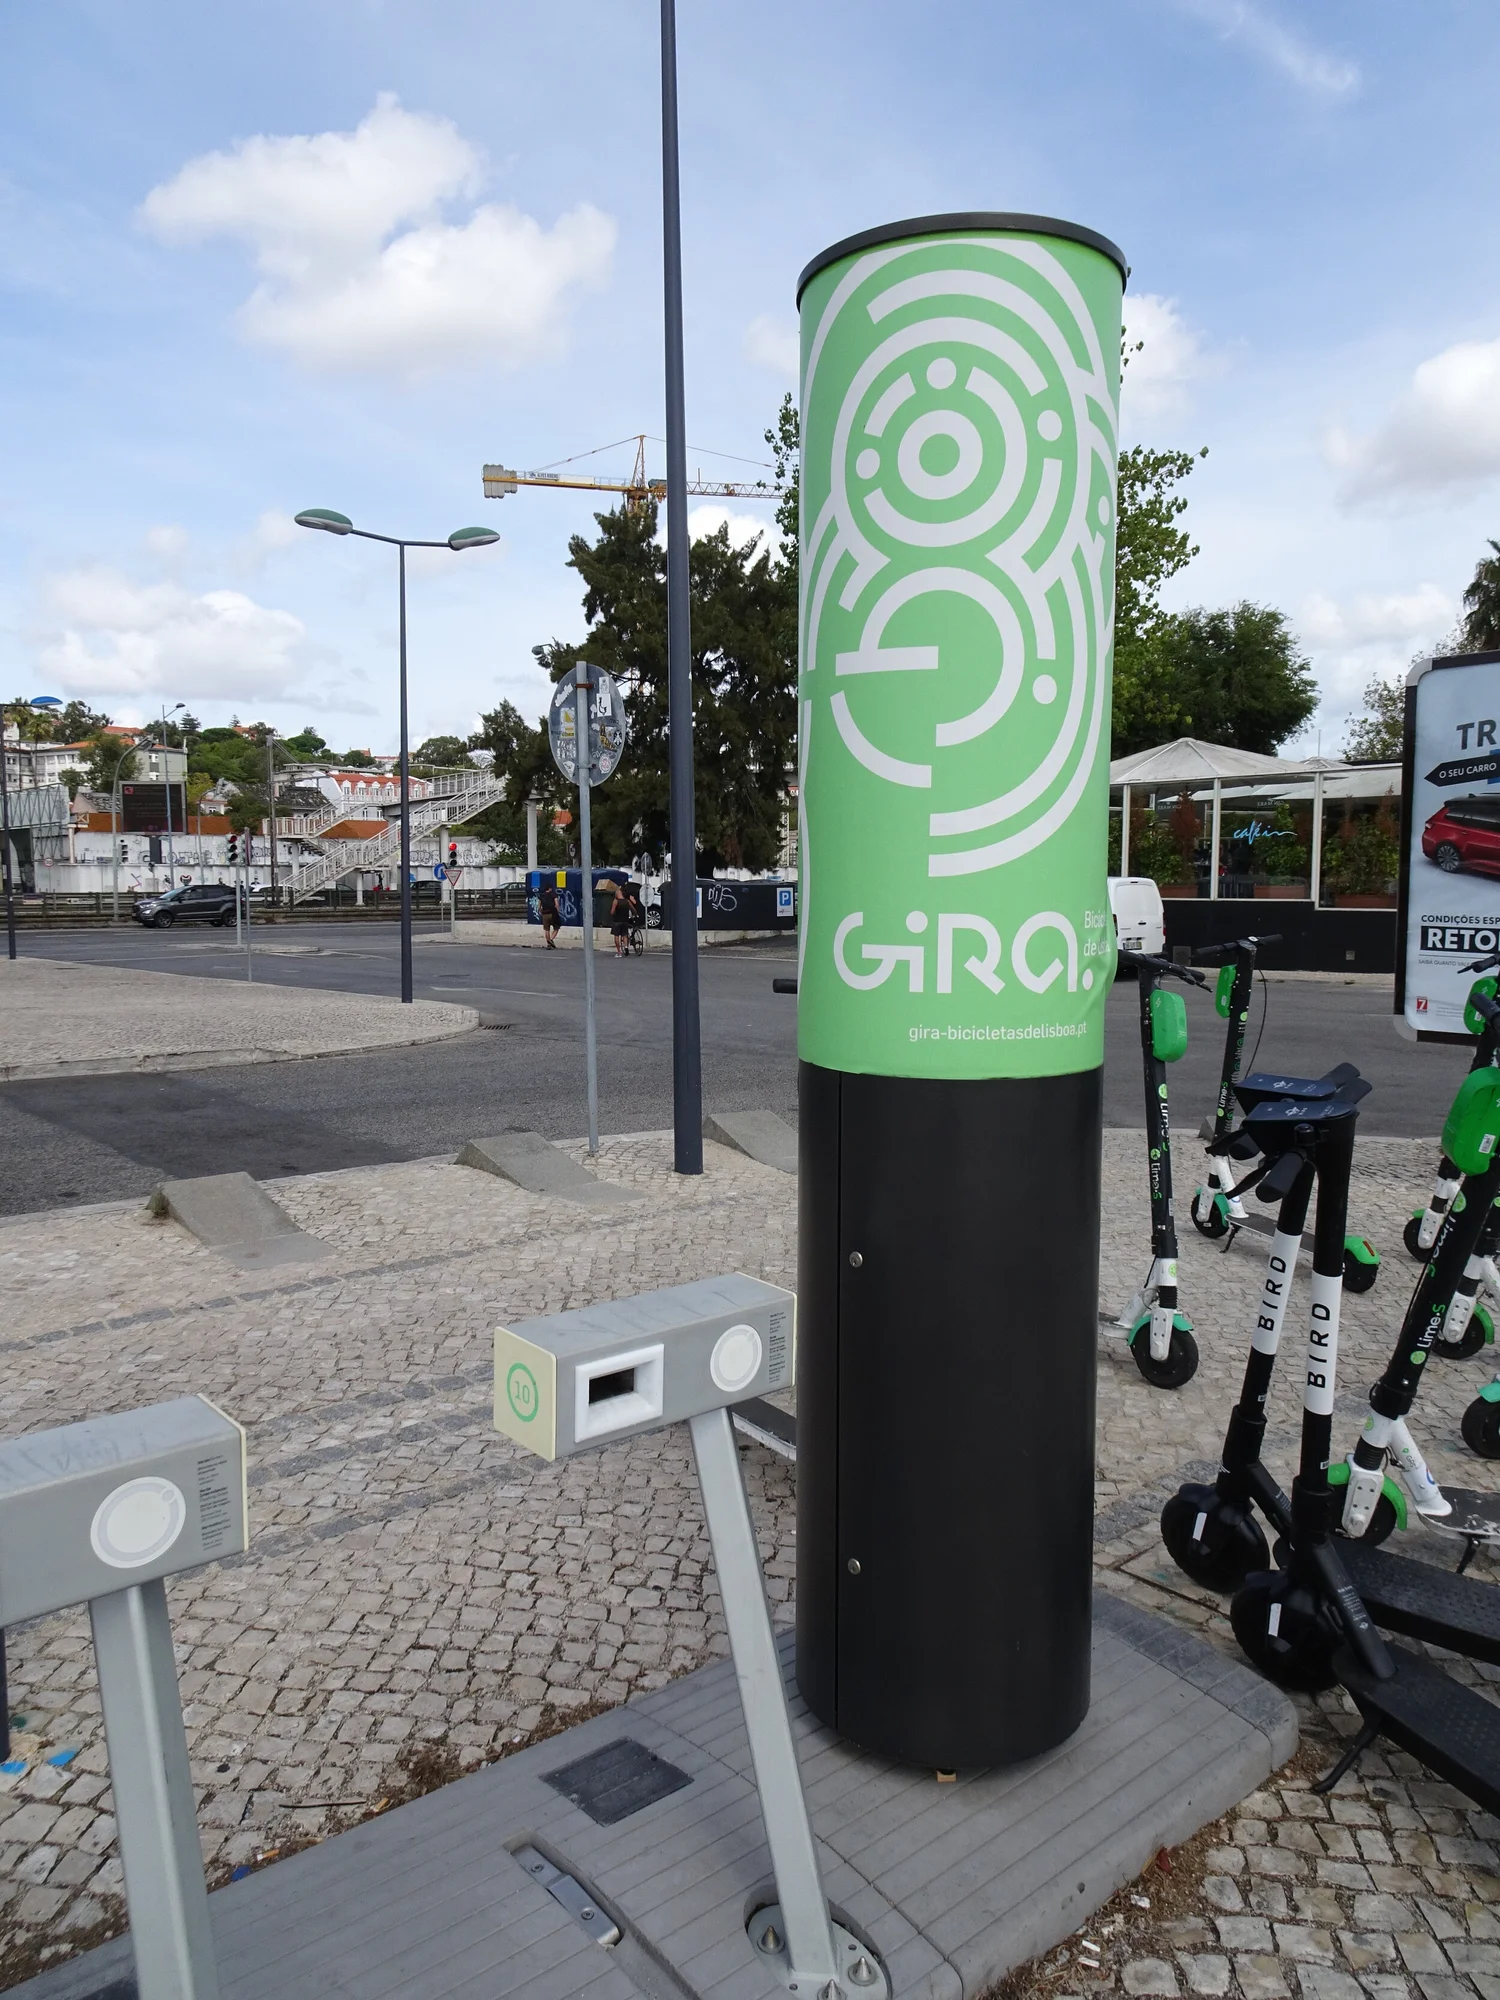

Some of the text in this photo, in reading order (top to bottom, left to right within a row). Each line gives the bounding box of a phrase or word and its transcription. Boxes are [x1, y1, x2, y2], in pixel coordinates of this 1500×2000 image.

[1439, 762, 1497, 779] O SEU CARRO
[1421, 914, 1480, 925] CONDIÇÕES
[1083, 938, 1097, 956] de
[1427, 928, 1500, 951] RETO
[909, 1021, 1087, 1042] gira-bicicletasdelisboa.pt
[1257, 1256, 1287, 1332] BIRD
[1307, 1303, 1331, 1389] BIRD
[515, 1381, 530, 1405] 10
